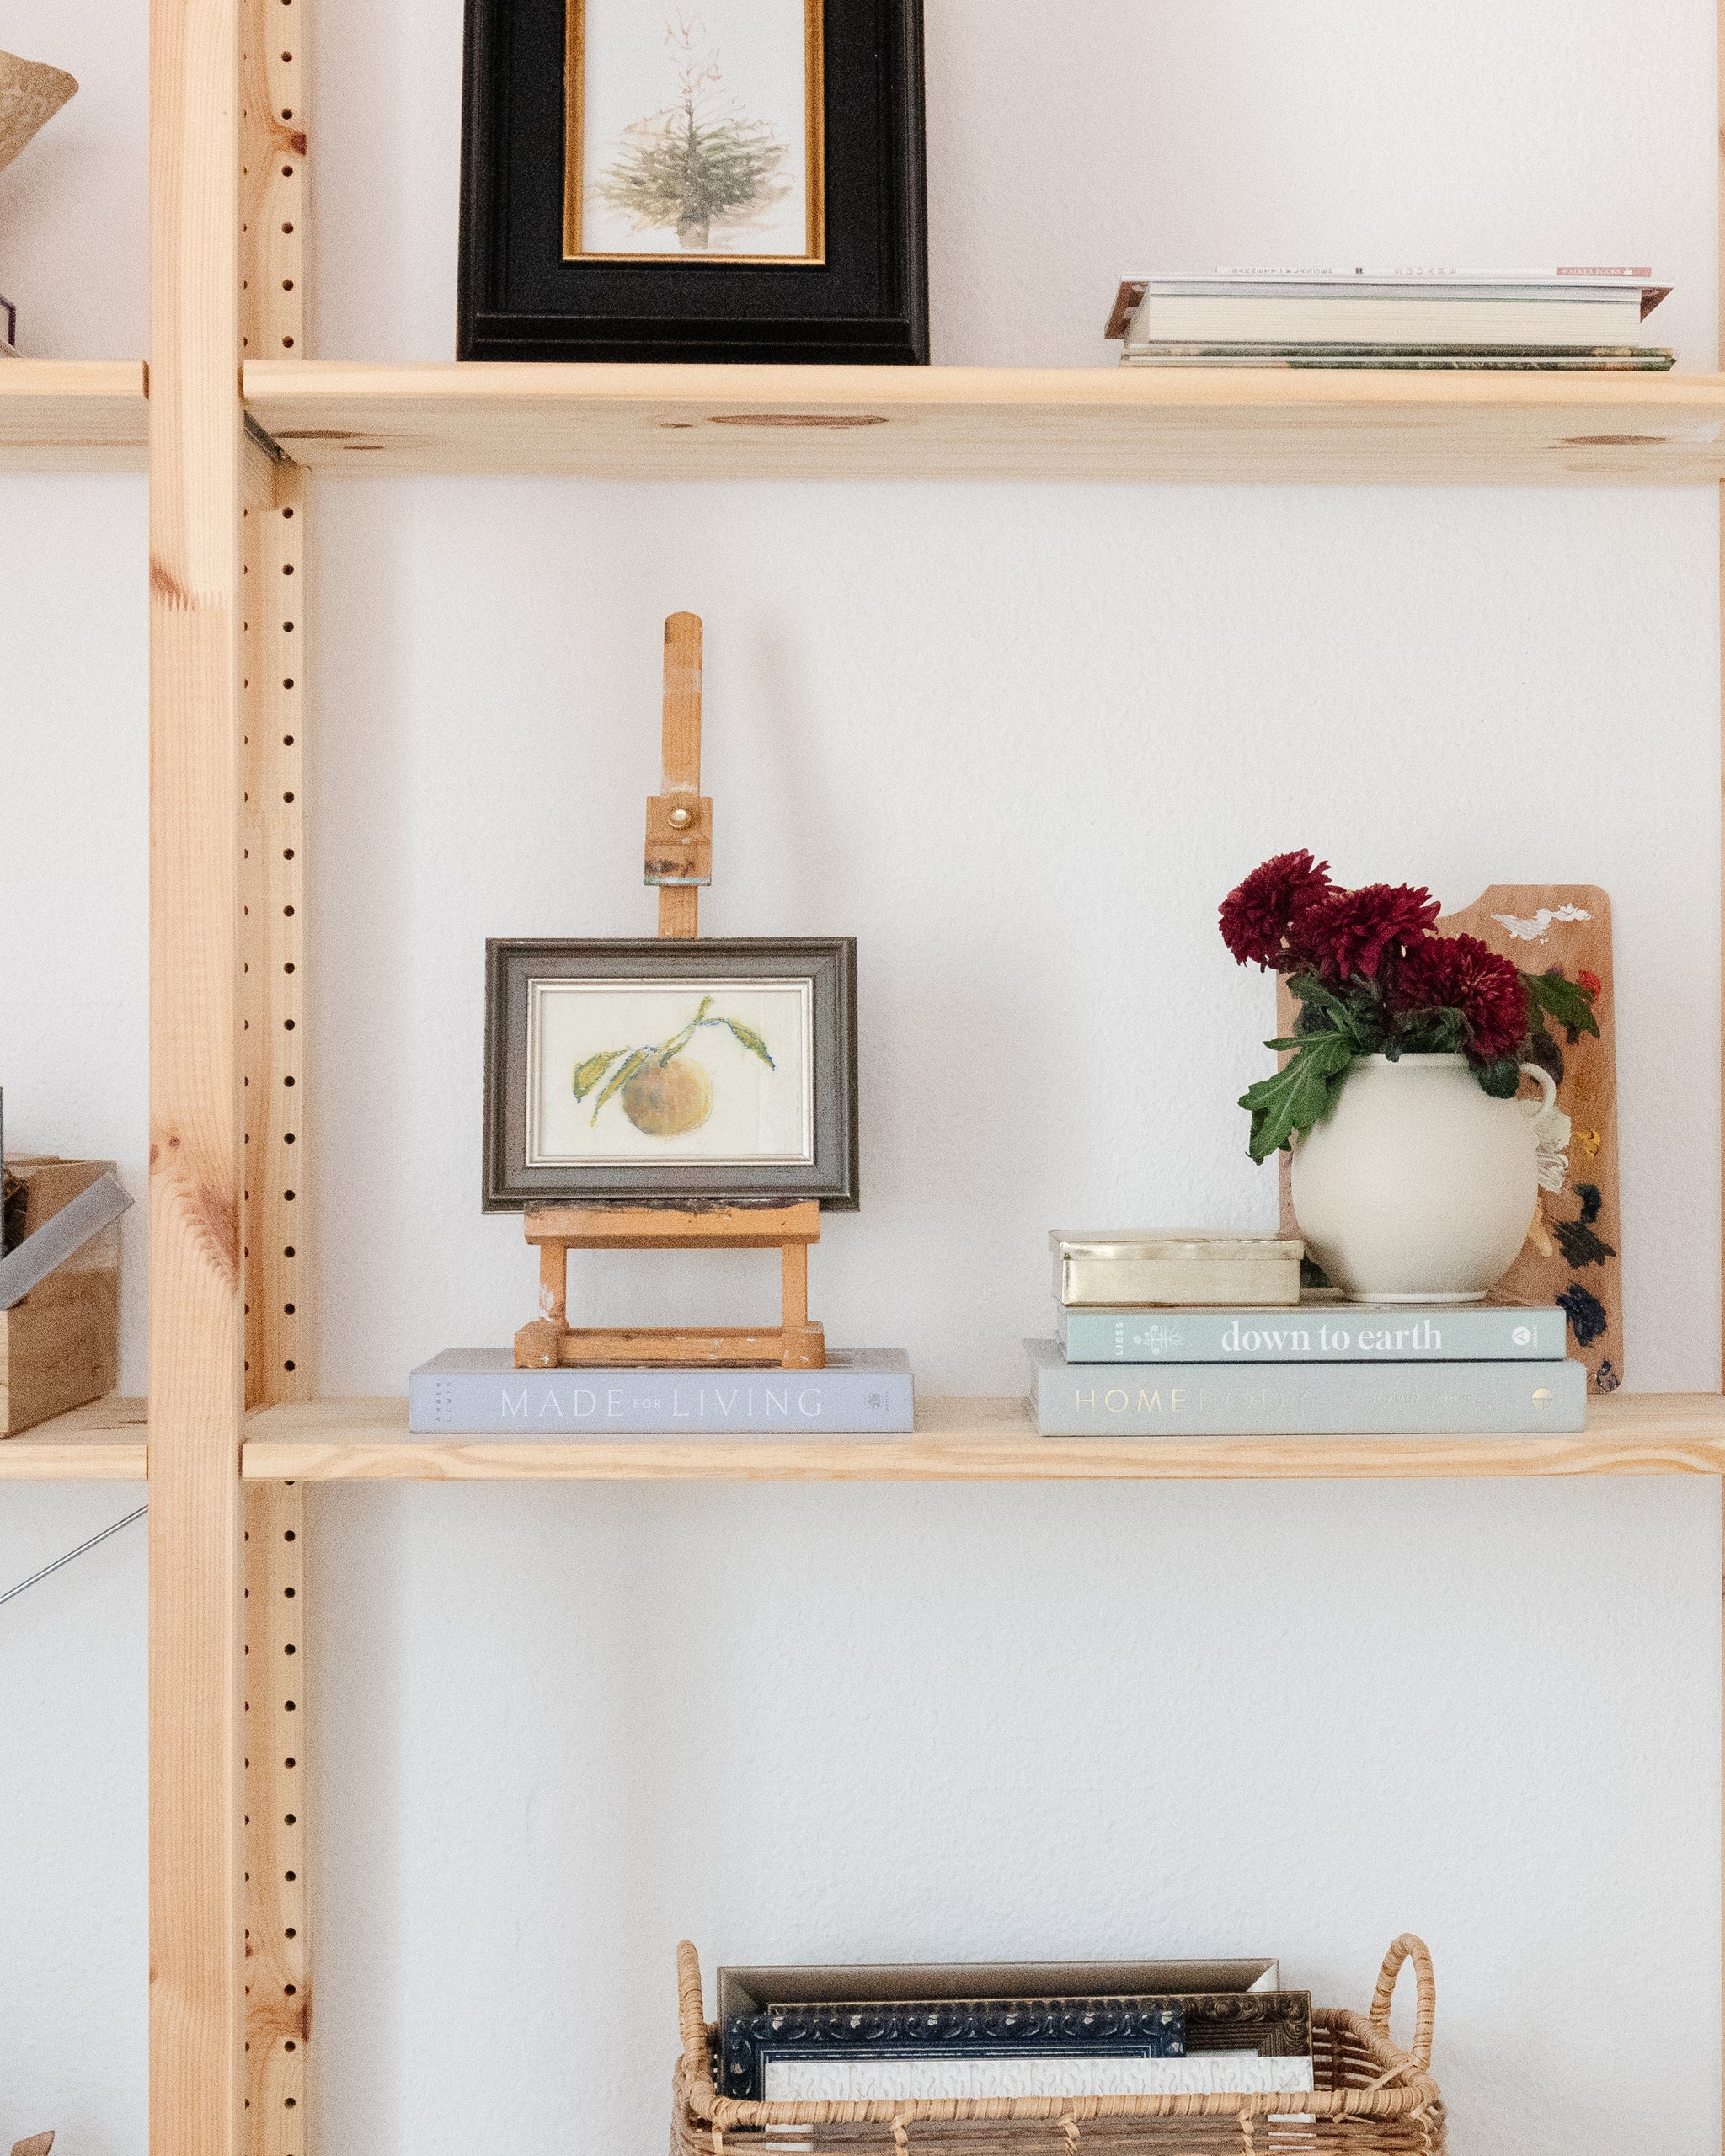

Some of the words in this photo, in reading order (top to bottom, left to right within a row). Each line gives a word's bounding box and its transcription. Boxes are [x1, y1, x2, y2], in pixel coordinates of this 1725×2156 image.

[1221, 1321, 1311, 1351] down
[1317, 1324, 1350, 1351] to
[1358, 1319, 1443, 1350] earth
[501, 1389, 623, 1417] MADE
[633, 1398, 662, 1410] FOR
[673, 1388, 821, 1417] LIVING
